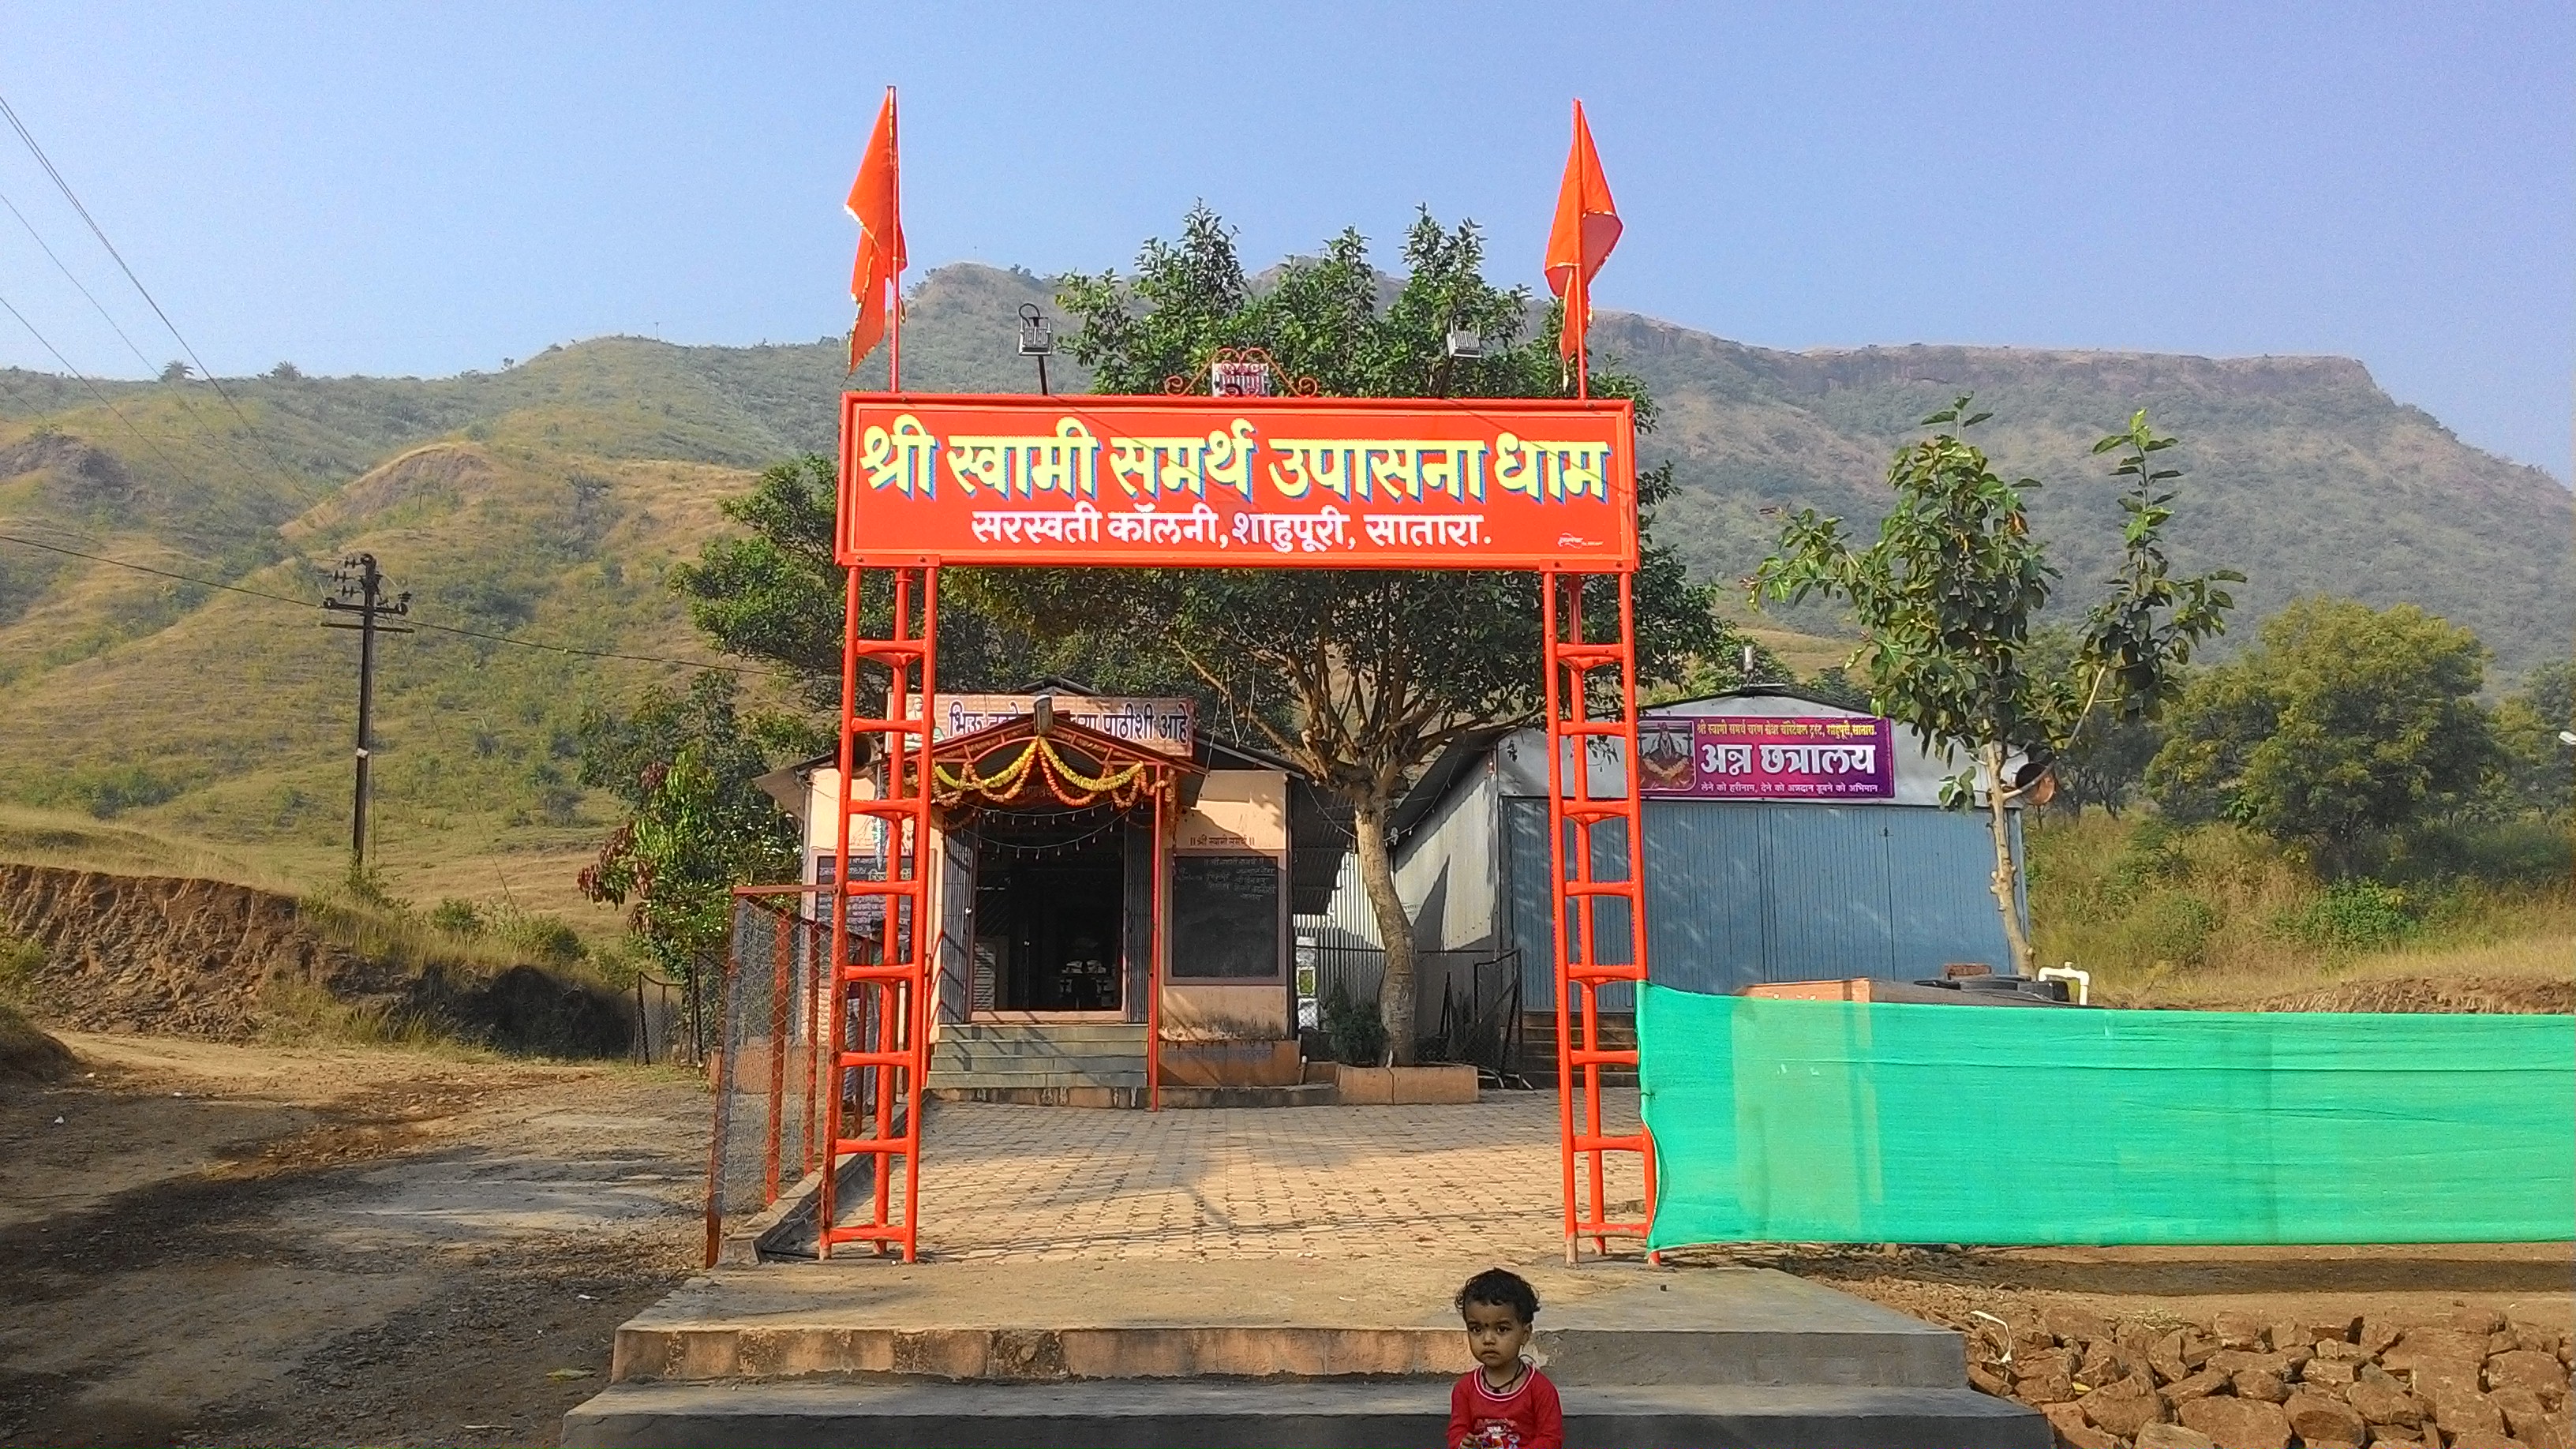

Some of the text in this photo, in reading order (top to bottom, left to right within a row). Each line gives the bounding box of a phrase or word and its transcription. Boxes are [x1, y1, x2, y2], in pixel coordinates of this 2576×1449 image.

[859, 414, 1612, 505] श्री स्वामी समर्थ उपासना धाम
[971, 500, 1103, 543] सरस्वती
[1363, 514, 1492, 546] सातारा.
[1103, 702, 1154, 739] पाठीशी
[1159, 702, 1188, 744] आहे
[1697, 719, 1706, 735] श्री
[1707, 719, 1727, 735] स्वामी
[1728, 719, 1746, 735] समर्थ
[1701, 744, 1876, 775] अन्न छत्रालय
[1701, 781, 1714, 792] लेने
[1716, 781, 1727, 792] को
[1760, 781, 1772, 792] देने
[1774, 781, 1785, 792] को
[1835, 782, 1846, 792] को
[1848, 782, 1878, 792] अभिमान
